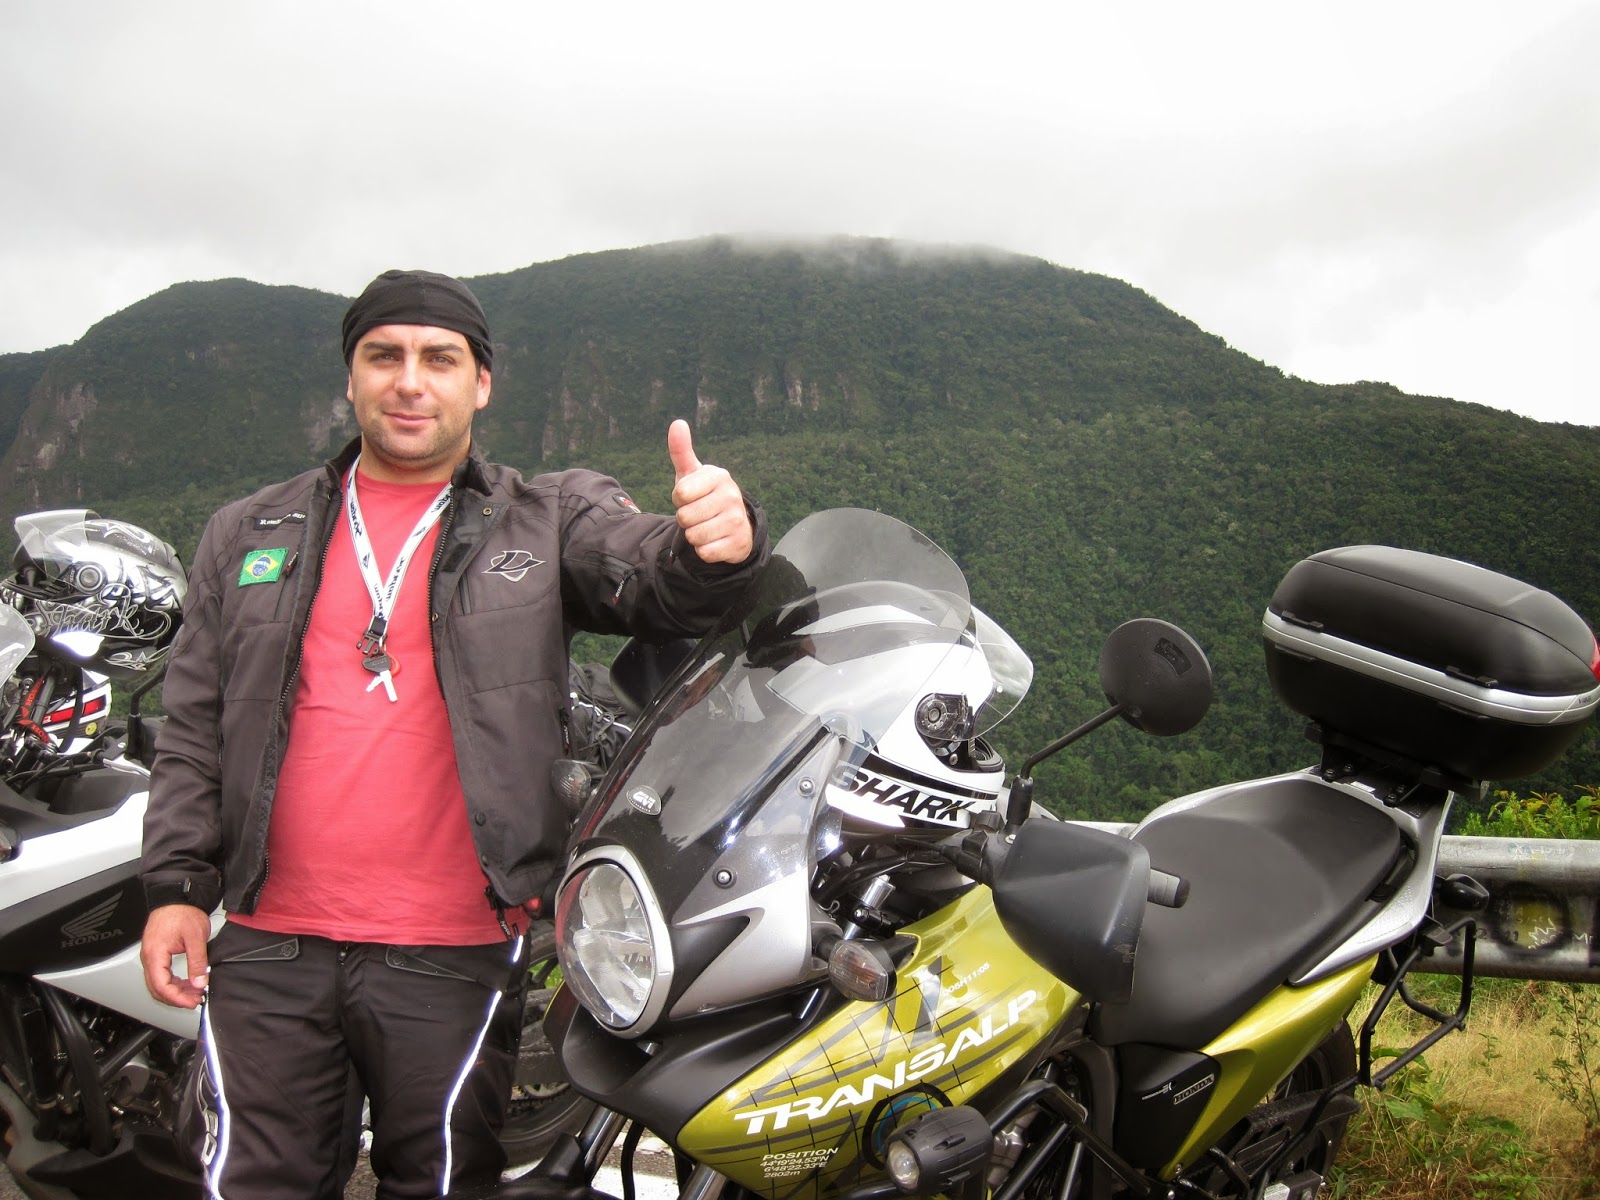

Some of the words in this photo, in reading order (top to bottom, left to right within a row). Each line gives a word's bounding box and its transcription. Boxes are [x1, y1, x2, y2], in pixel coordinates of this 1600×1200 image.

[831, 759, 975, 822] SHARK
[60, 929, 125, 949] HONDA
[733, 989, 1038, 1136] TRANSALP
[1175, 1074, 1214, 1104] HONDA
[762, 1147, 839, 1161] POSITION
[763, 1170, 801, 1178] 2802m
